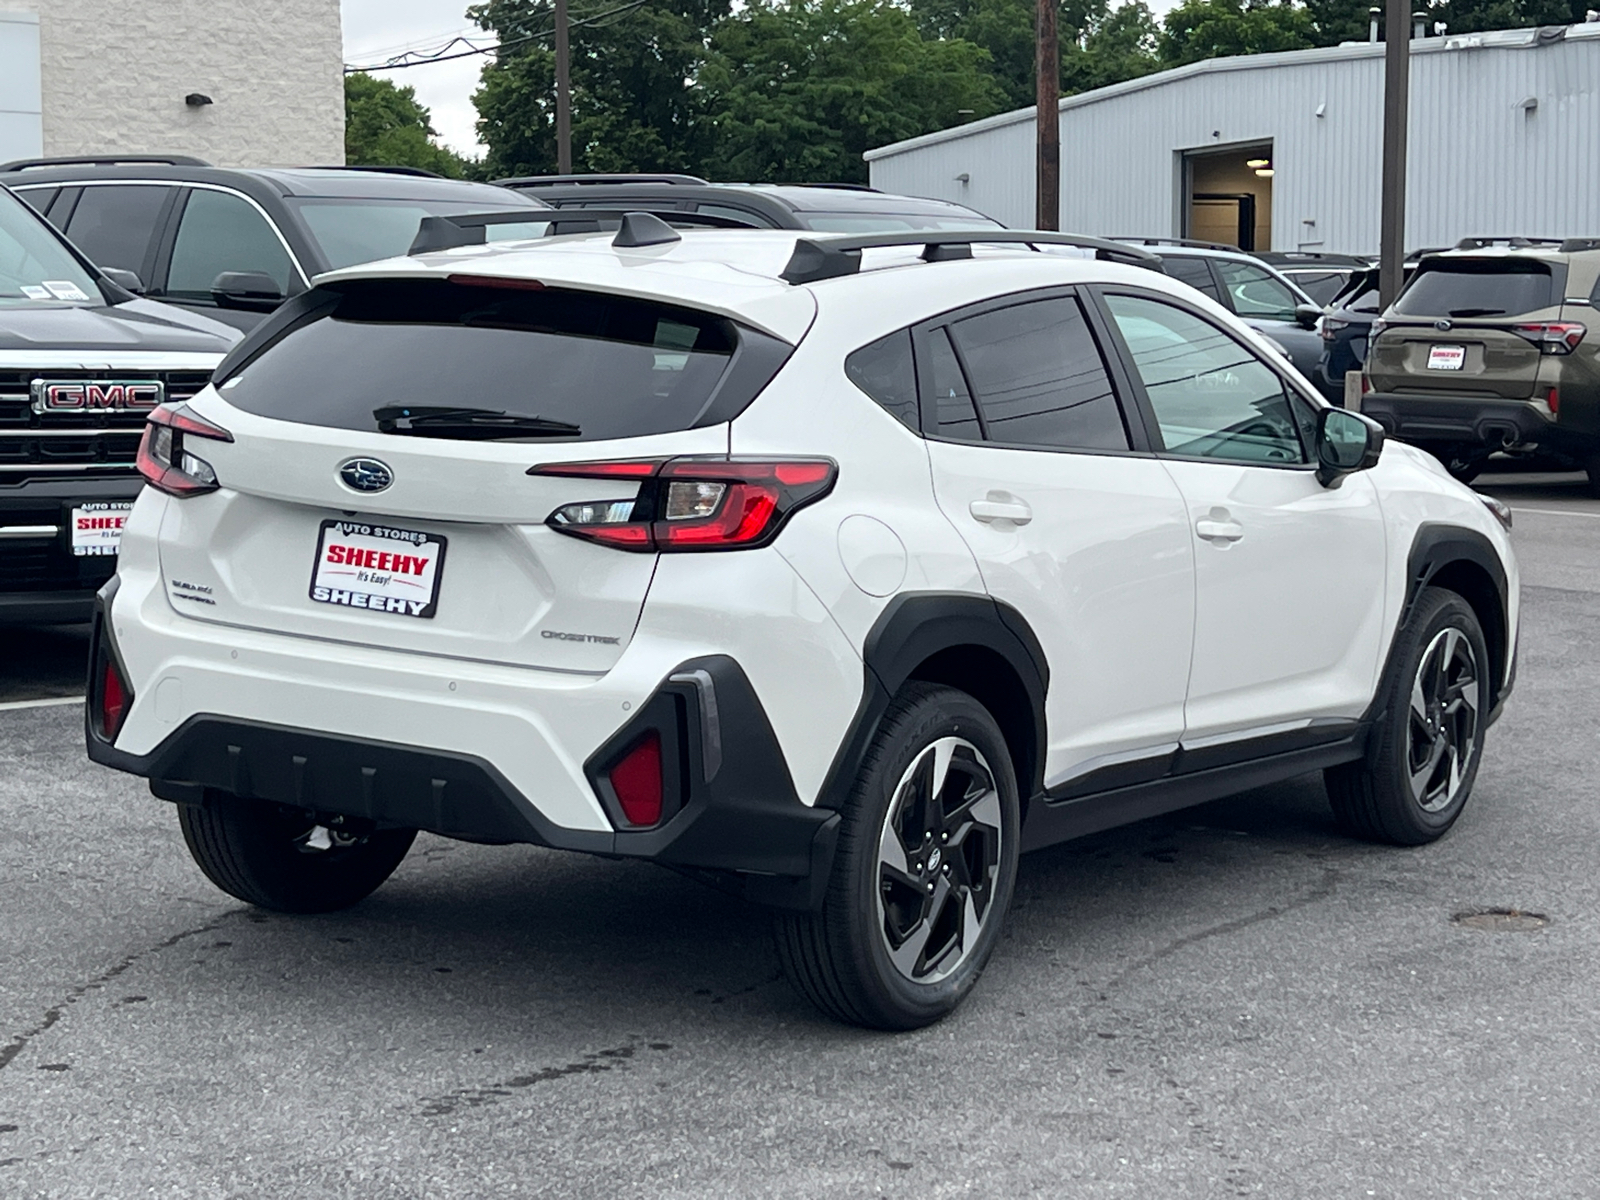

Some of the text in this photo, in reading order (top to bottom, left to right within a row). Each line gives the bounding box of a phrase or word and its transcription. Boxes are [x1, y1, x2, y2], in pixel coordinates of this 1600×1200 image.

[47, 385, 159, 408] GMC
[77, 516, 128, 530] SHEE
[334, 522, 428, 543] AUTO STORES
[326, 544, 430, 576] SHEEHY
[357, 570, 393, 587] It's Easy!
[312, 587, 428, 616] SHEEHY
